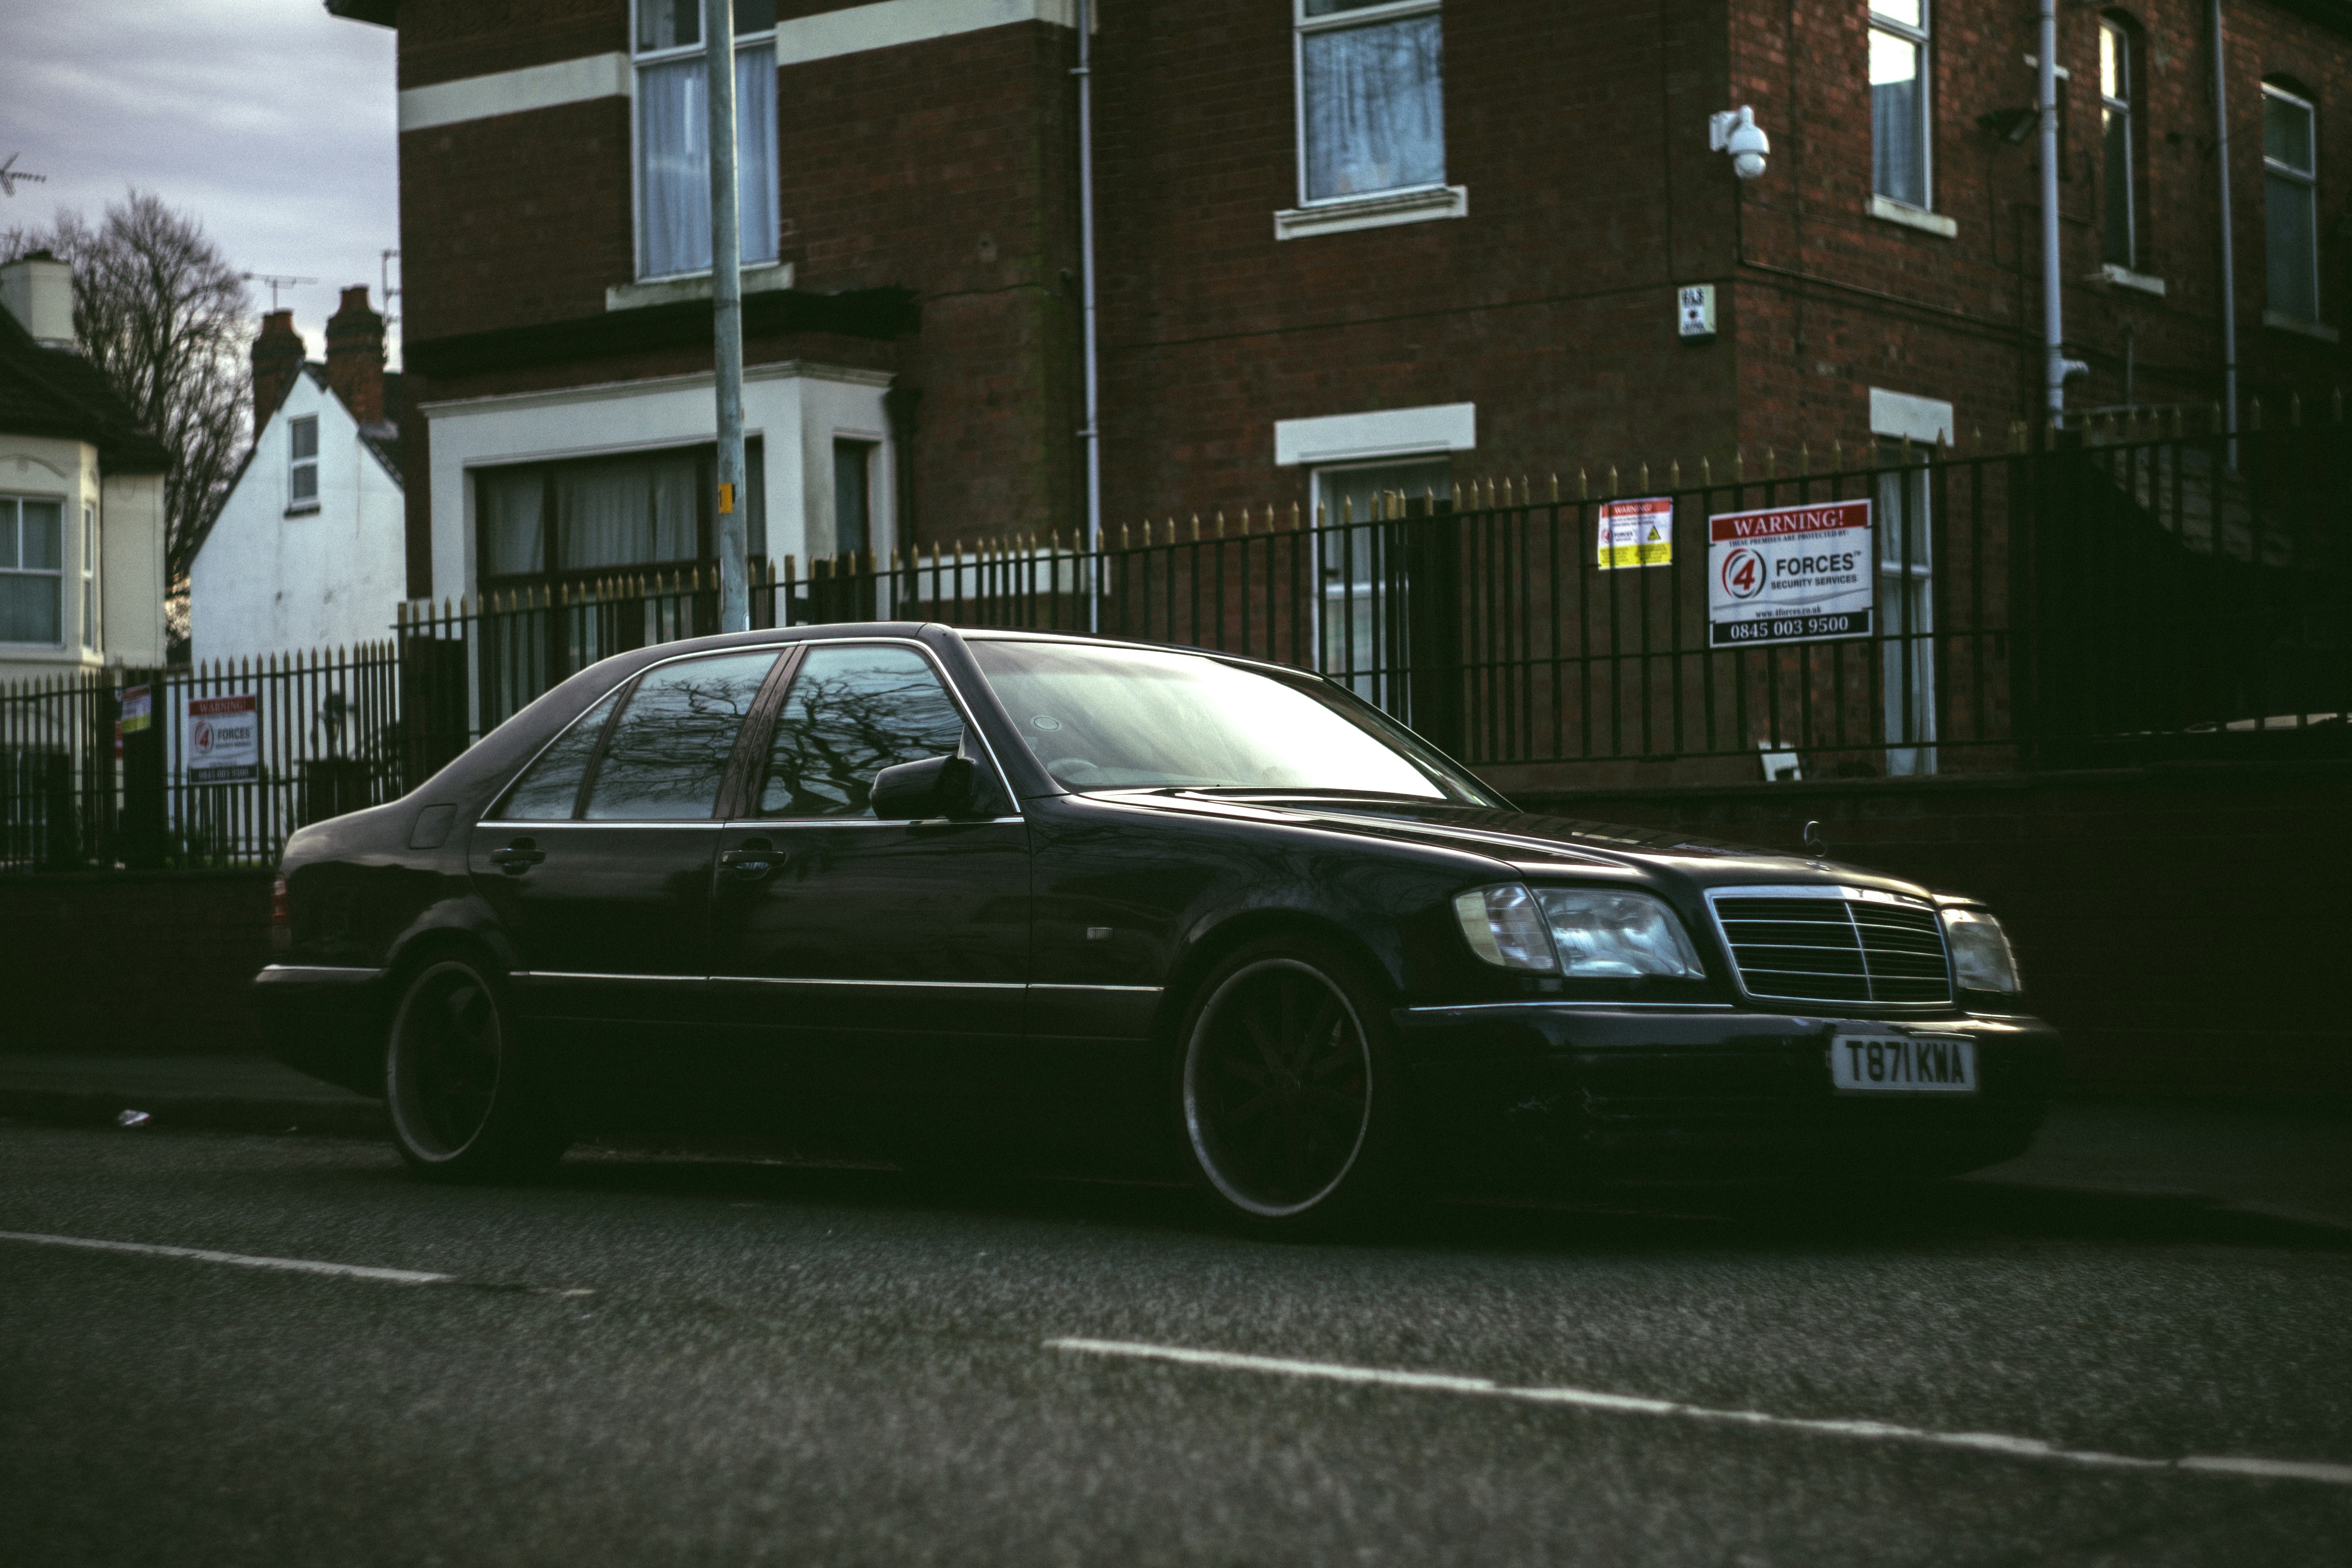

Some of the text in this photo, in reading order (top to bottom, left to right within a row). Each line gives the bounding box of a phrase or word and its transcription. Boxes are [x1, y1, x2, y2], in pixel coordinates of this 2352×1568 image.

[1734, 510, 1844, 537] WARNING!
[1729, 539, 1748, 547] THESE
[1749, 536, 1781, 545] PREMISES
[1784, 534, 1795, 542] ARE
[1797, 531, 1837, 541] PROTECTED
[1733, 559, 1755, 590] 4
[1771, 574, 1857, 590] SECURITY SERVICES
[1731, 616, 1849, 639] 0845 003 9500
[200, 699, 246, 713] WARNING!
